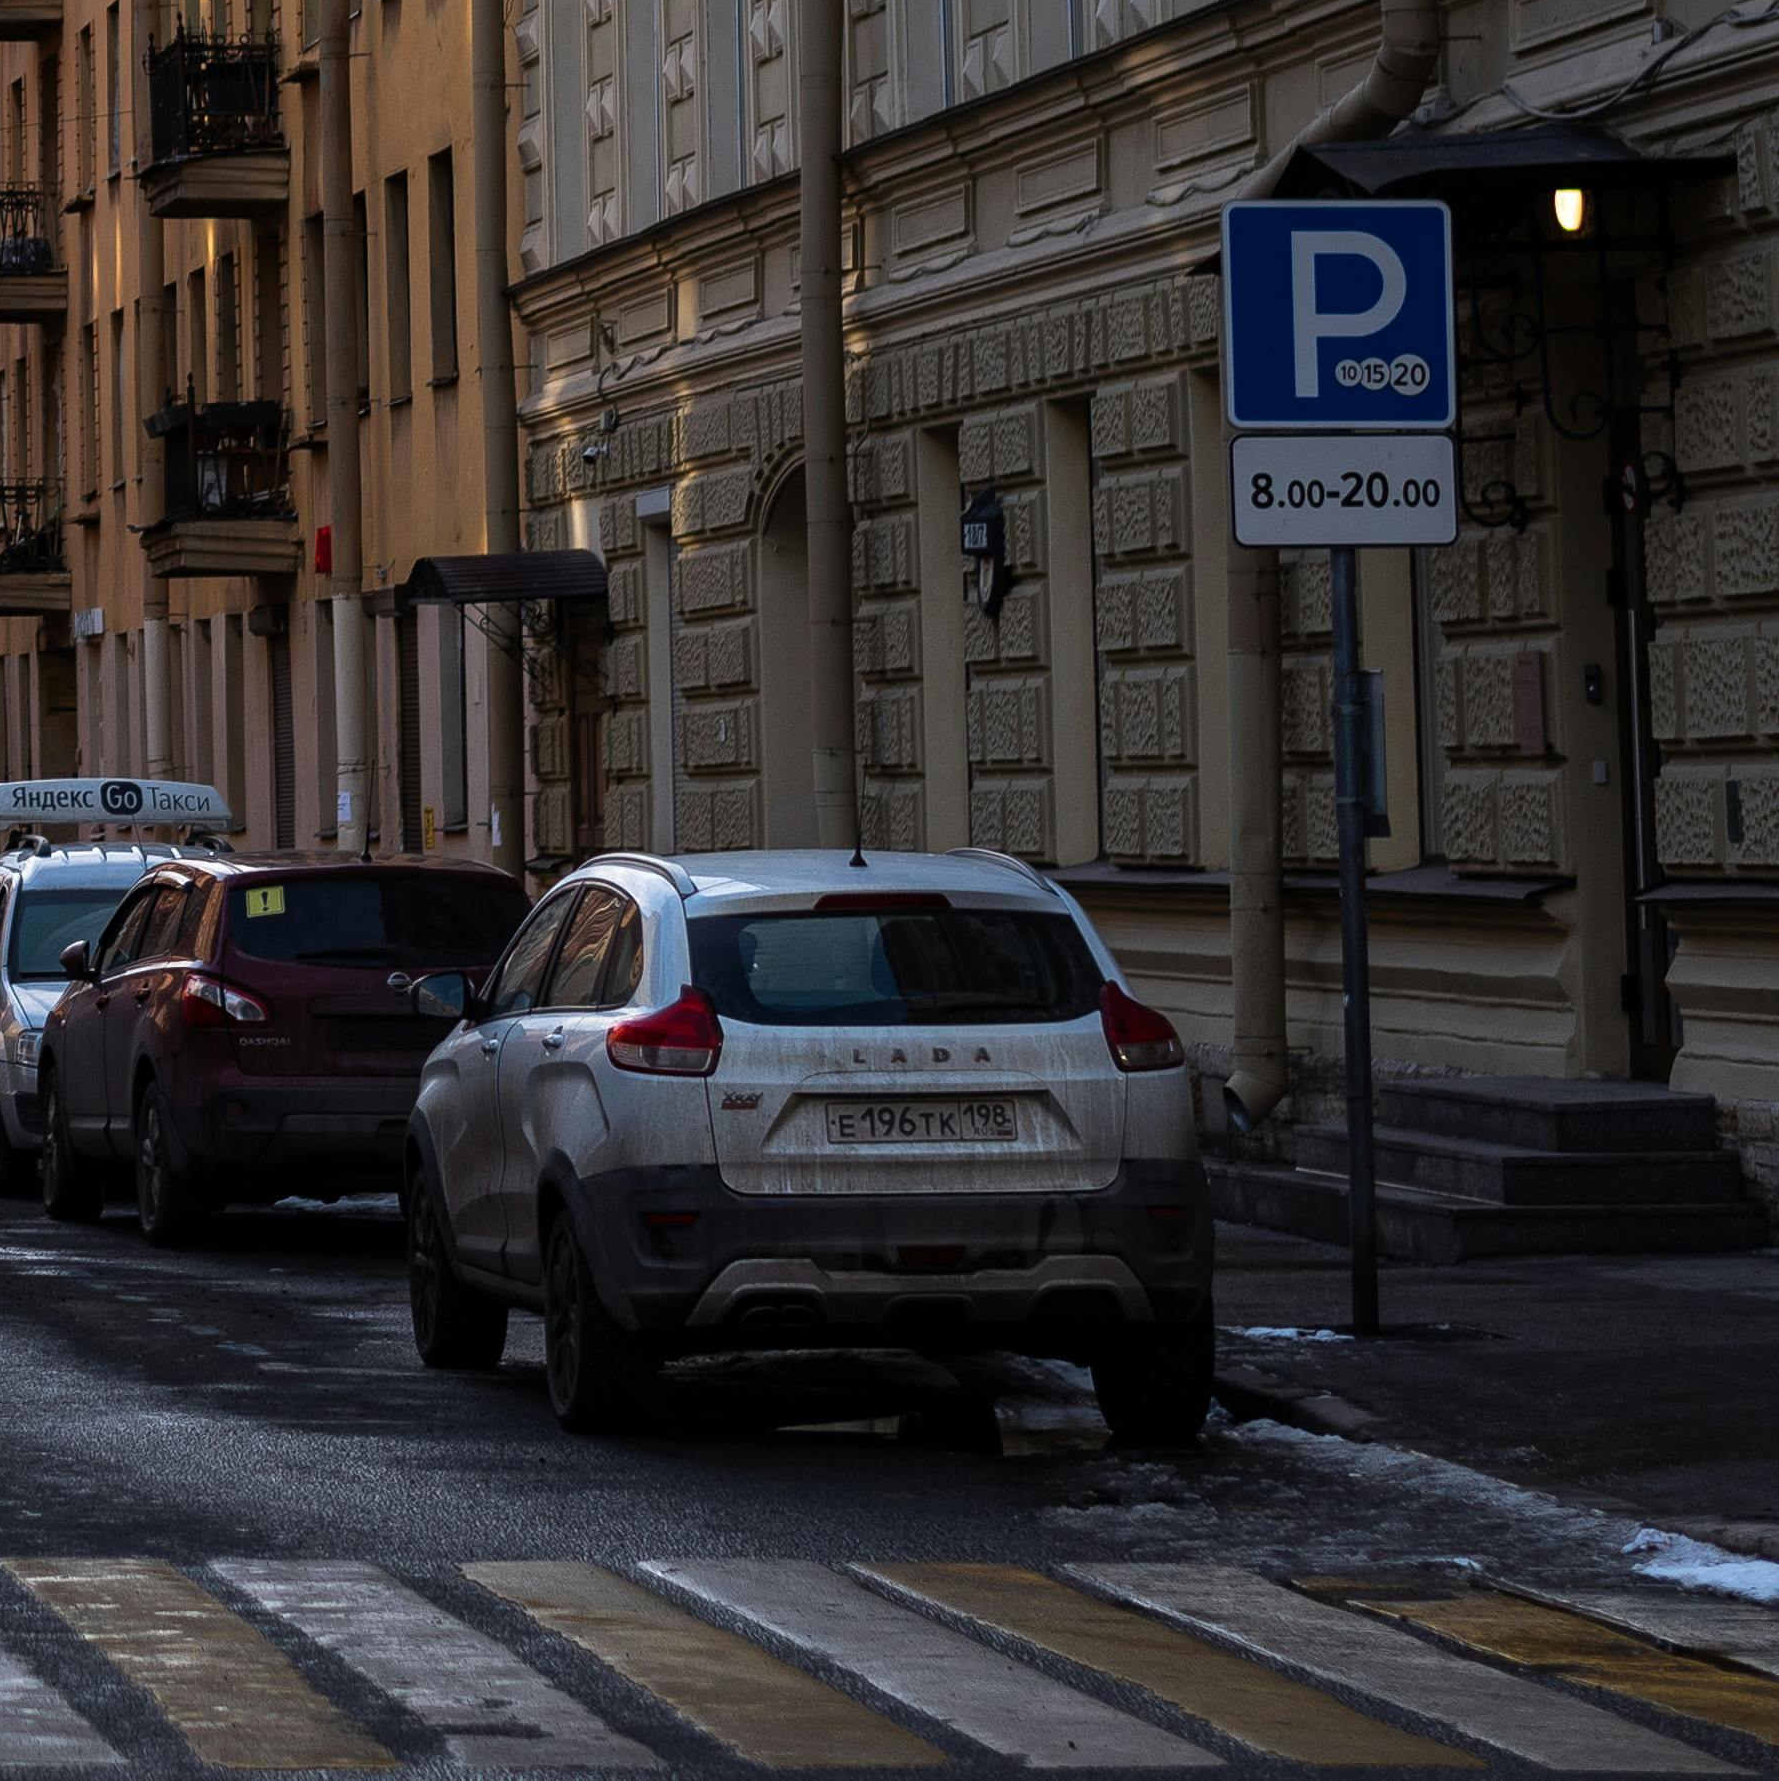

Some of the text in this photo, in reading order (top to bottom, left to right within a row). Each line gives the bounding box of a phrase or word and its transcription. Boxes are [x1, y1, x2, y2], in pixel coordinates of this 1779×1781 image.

[1291, 231, 1407, 398] P
[1340, 363, 1426, 387] 10 15 20
[1250, 472, 1440, 509] 8.00-20.00
[12, 785, 210, 812] Яндекс Go Такси
[239, 1037, 291, 1047] QASHQAI
[852, 1047, 991, 1064] LADA
[962, 1103, 1007, 1127] 198
